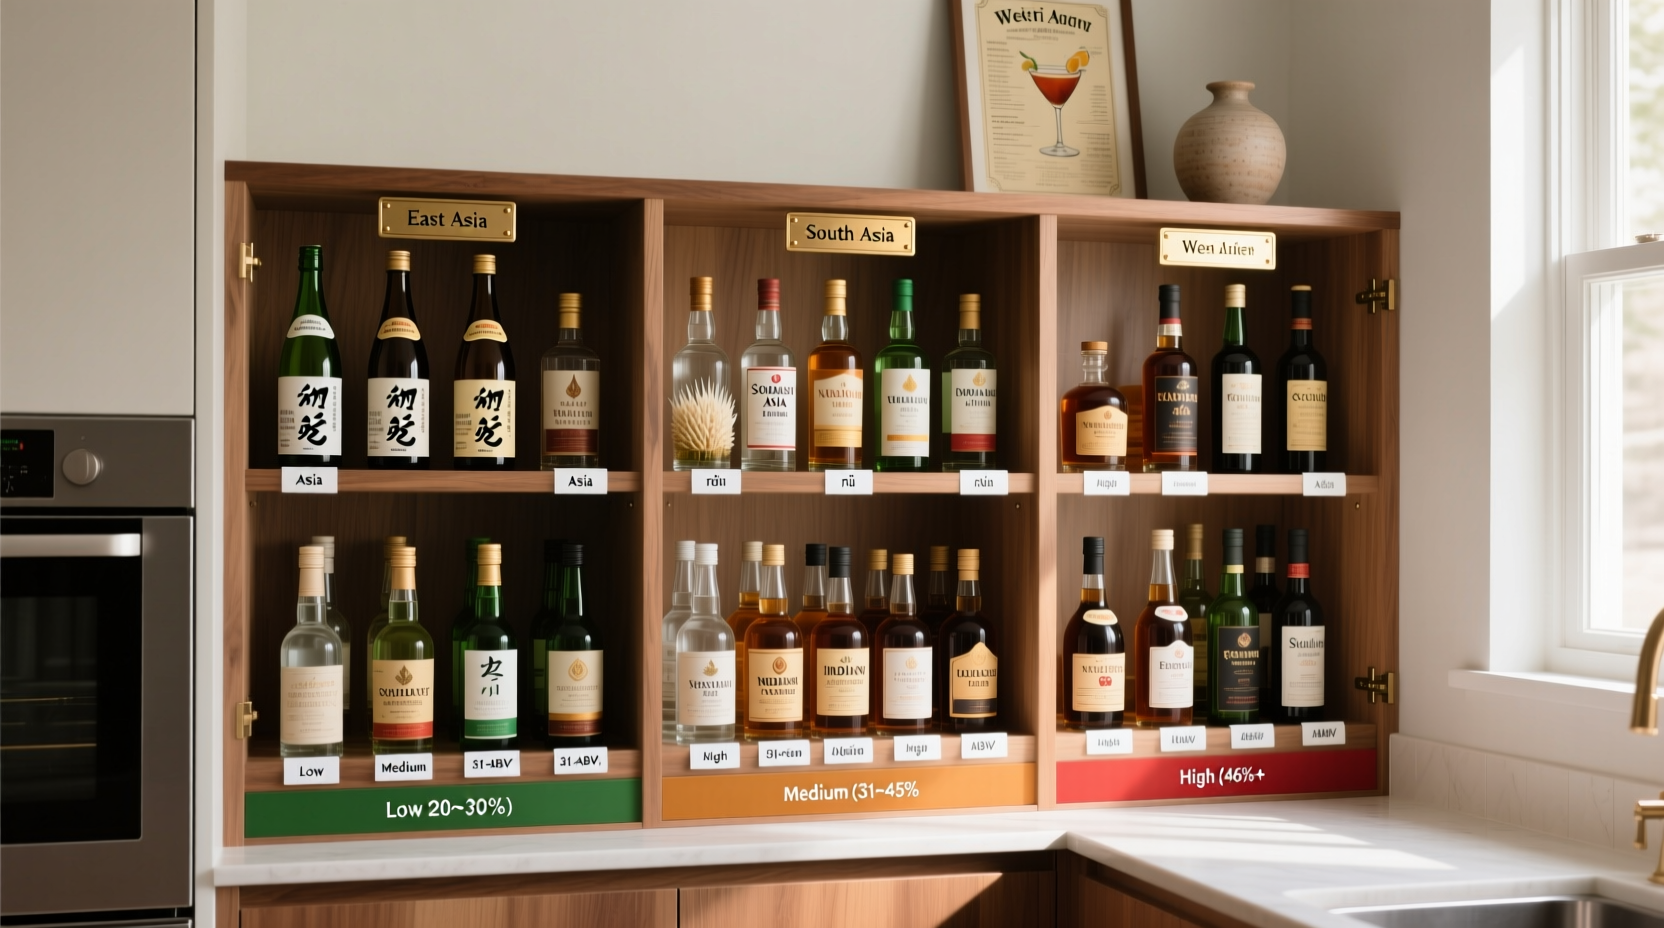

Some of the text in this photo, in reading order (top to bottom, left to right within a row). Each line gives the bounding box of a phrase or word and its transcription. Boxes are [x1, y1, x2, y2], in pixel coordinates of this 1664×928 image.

[407, 209, 488, 229] East Asia
[806, 224, 895, 243] South Asia
[295, 474, 323, 487] Asia
[568, 475, 593, 488] Asia
[299, 766, 324, 777] Low
[381, 761, 427, 773] Medium
[1180, 766, 1265, 789] High (46%+
[783, 783, 848, 801] Medium
[386, 801, 423, 818] Low
